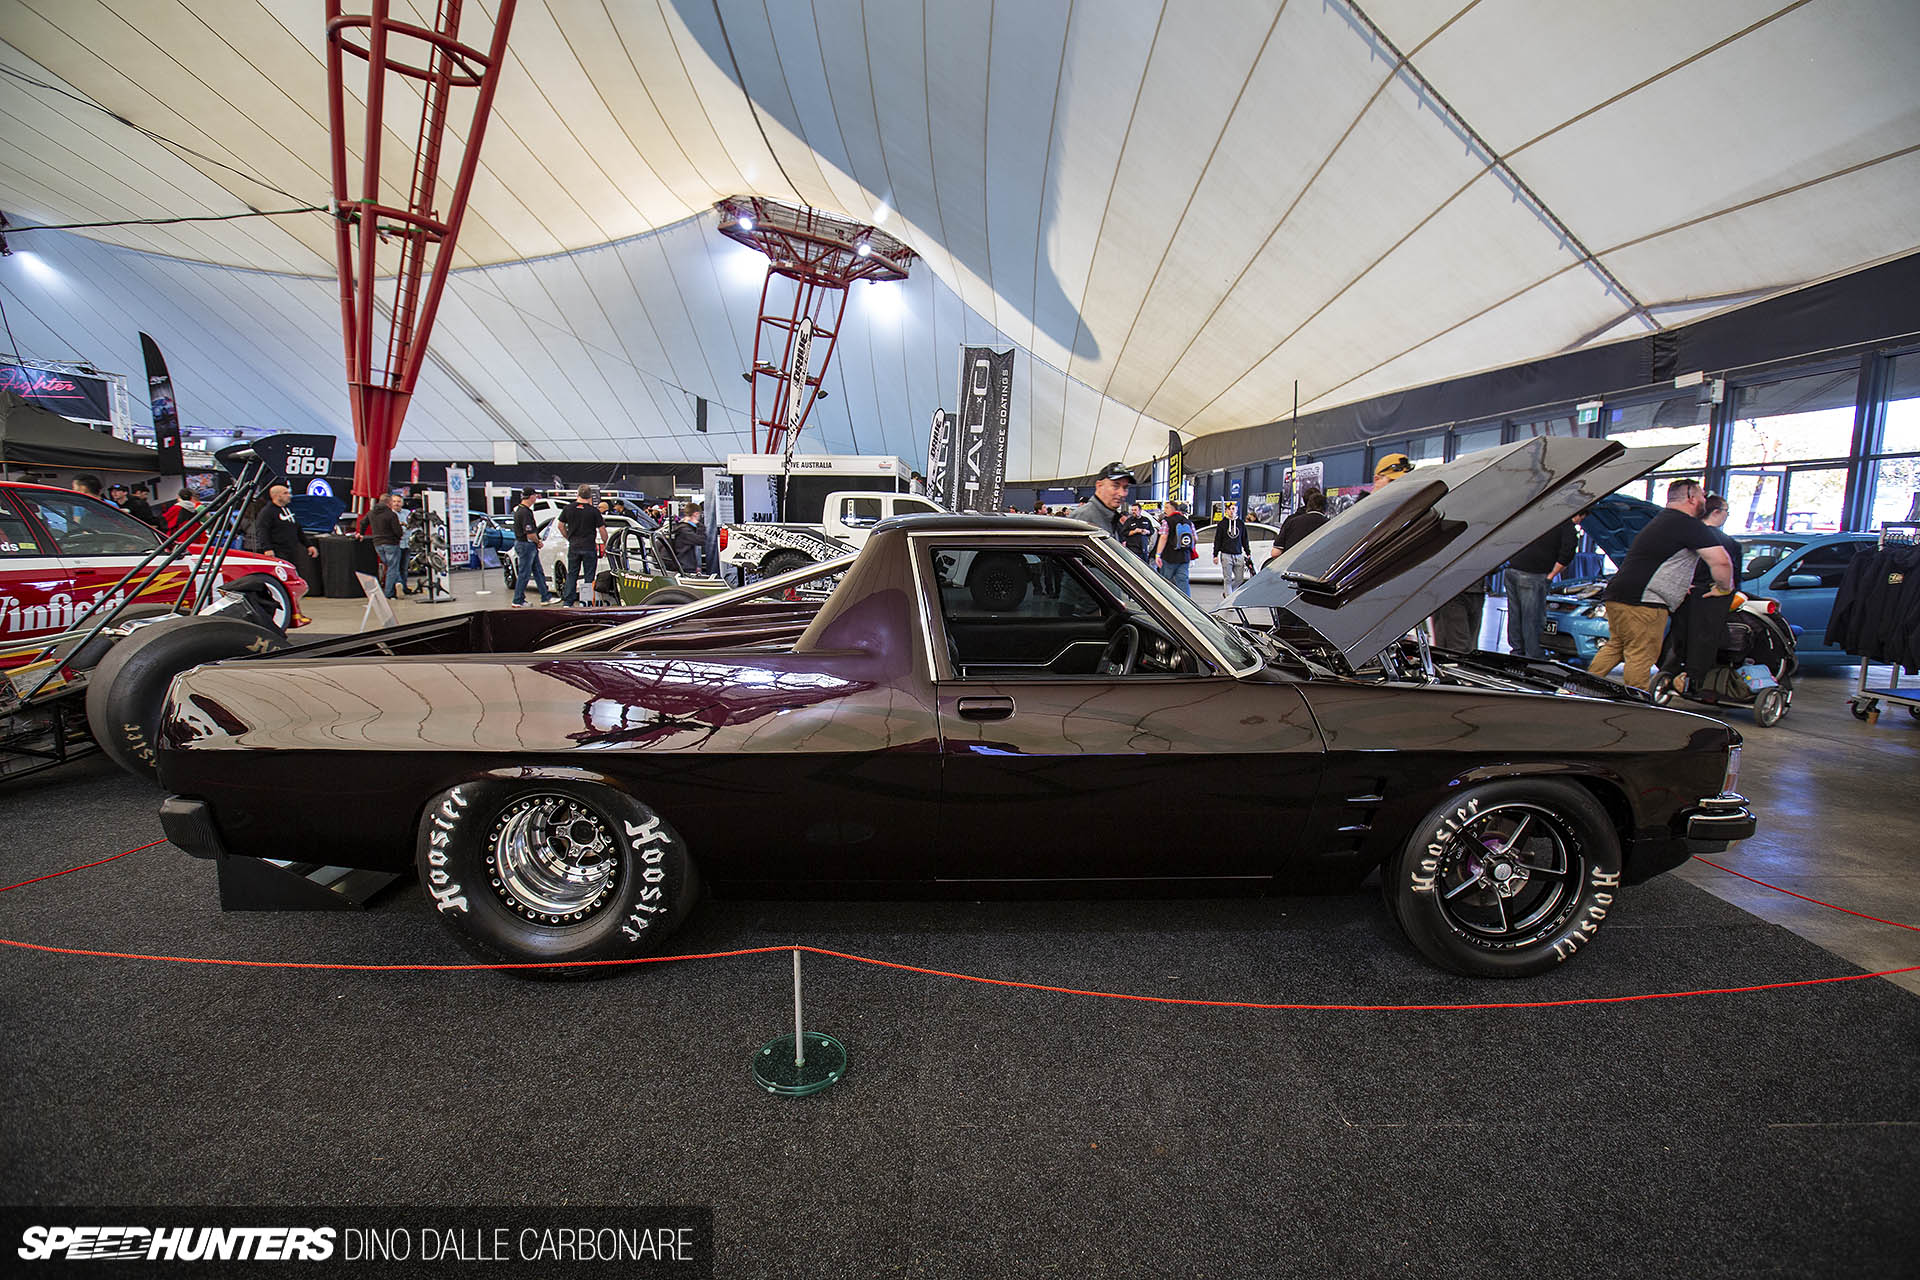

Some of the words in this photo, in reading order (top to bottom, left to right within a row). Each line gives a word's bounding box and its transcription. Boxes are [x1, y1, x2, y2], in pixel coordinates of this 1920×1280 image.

[286, 456, 330, 476] 869
[291, 446, 314, 456] SCO
[801, 461, 833, 469] AUSTRALIA
[992, 429, 1006, 511] PERFORMANCE
[999, 369, 1009, 426] COATINGS
[764, 528, 819, 551] UNLEASH
[427, 787, 469, 916] Hoosier
[622, 815, 672, 943] Hoosier
[1411, 798, 1479, 892] Hoosier
[1553, 865, 1620, 962] Hoosier
